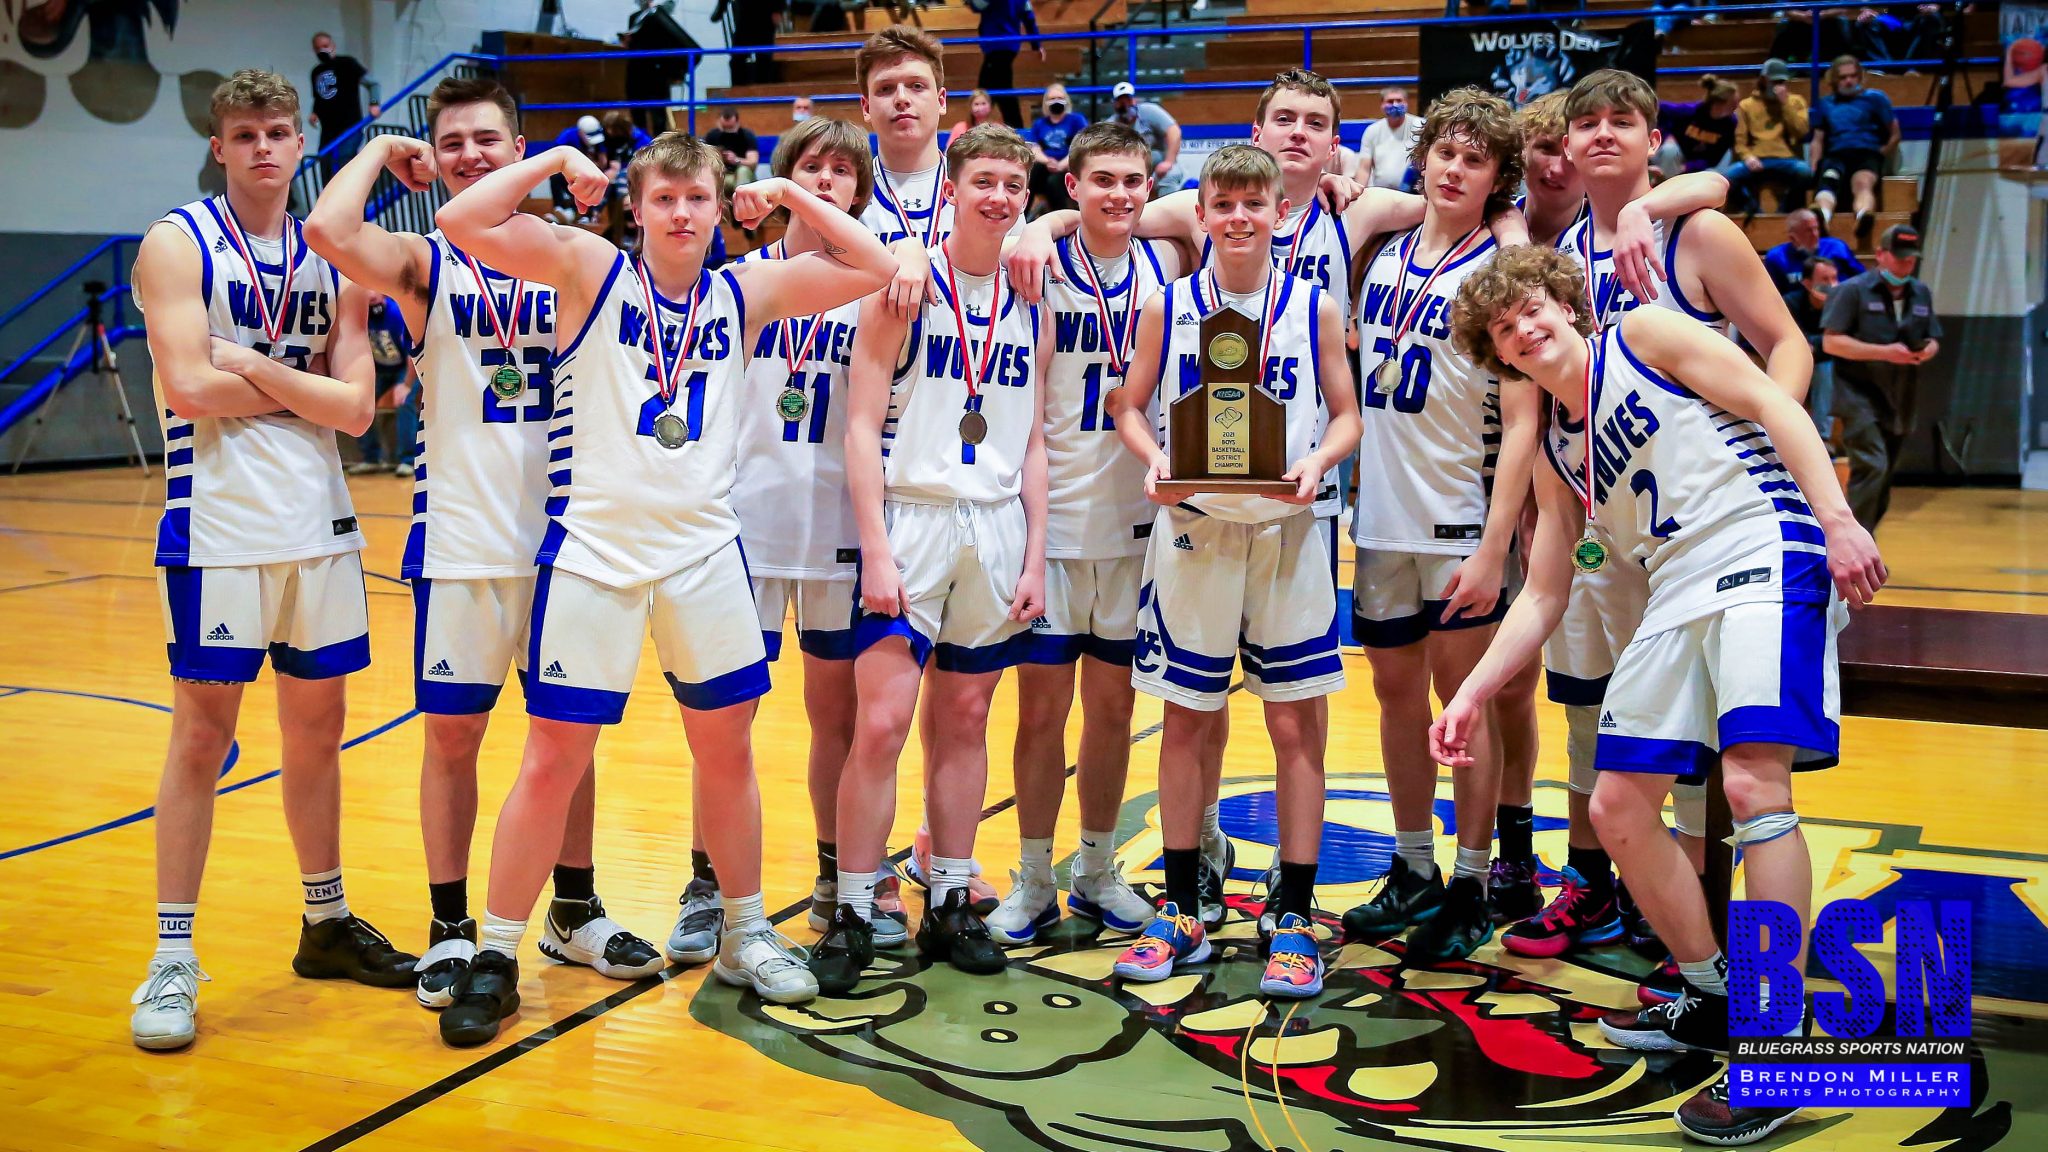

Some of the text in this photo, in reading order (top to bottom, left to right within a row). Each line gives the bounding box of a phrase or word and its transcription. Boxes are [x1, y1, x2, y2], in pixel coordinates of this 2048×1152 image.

[1470, 32, 1555, 52] WOLVES
[480, 347, 555, 423] 23
[636, 363, 709, 441] 21
[782, 371, 832, 443] 11
[1364, 337, 1432, 414] 20
[1630, 469, 1682, 537] 2
[206, 633, 234, 641] adidas
[428, 669, 454, 677] adidas
[543, 670, 567, 679] adidas
